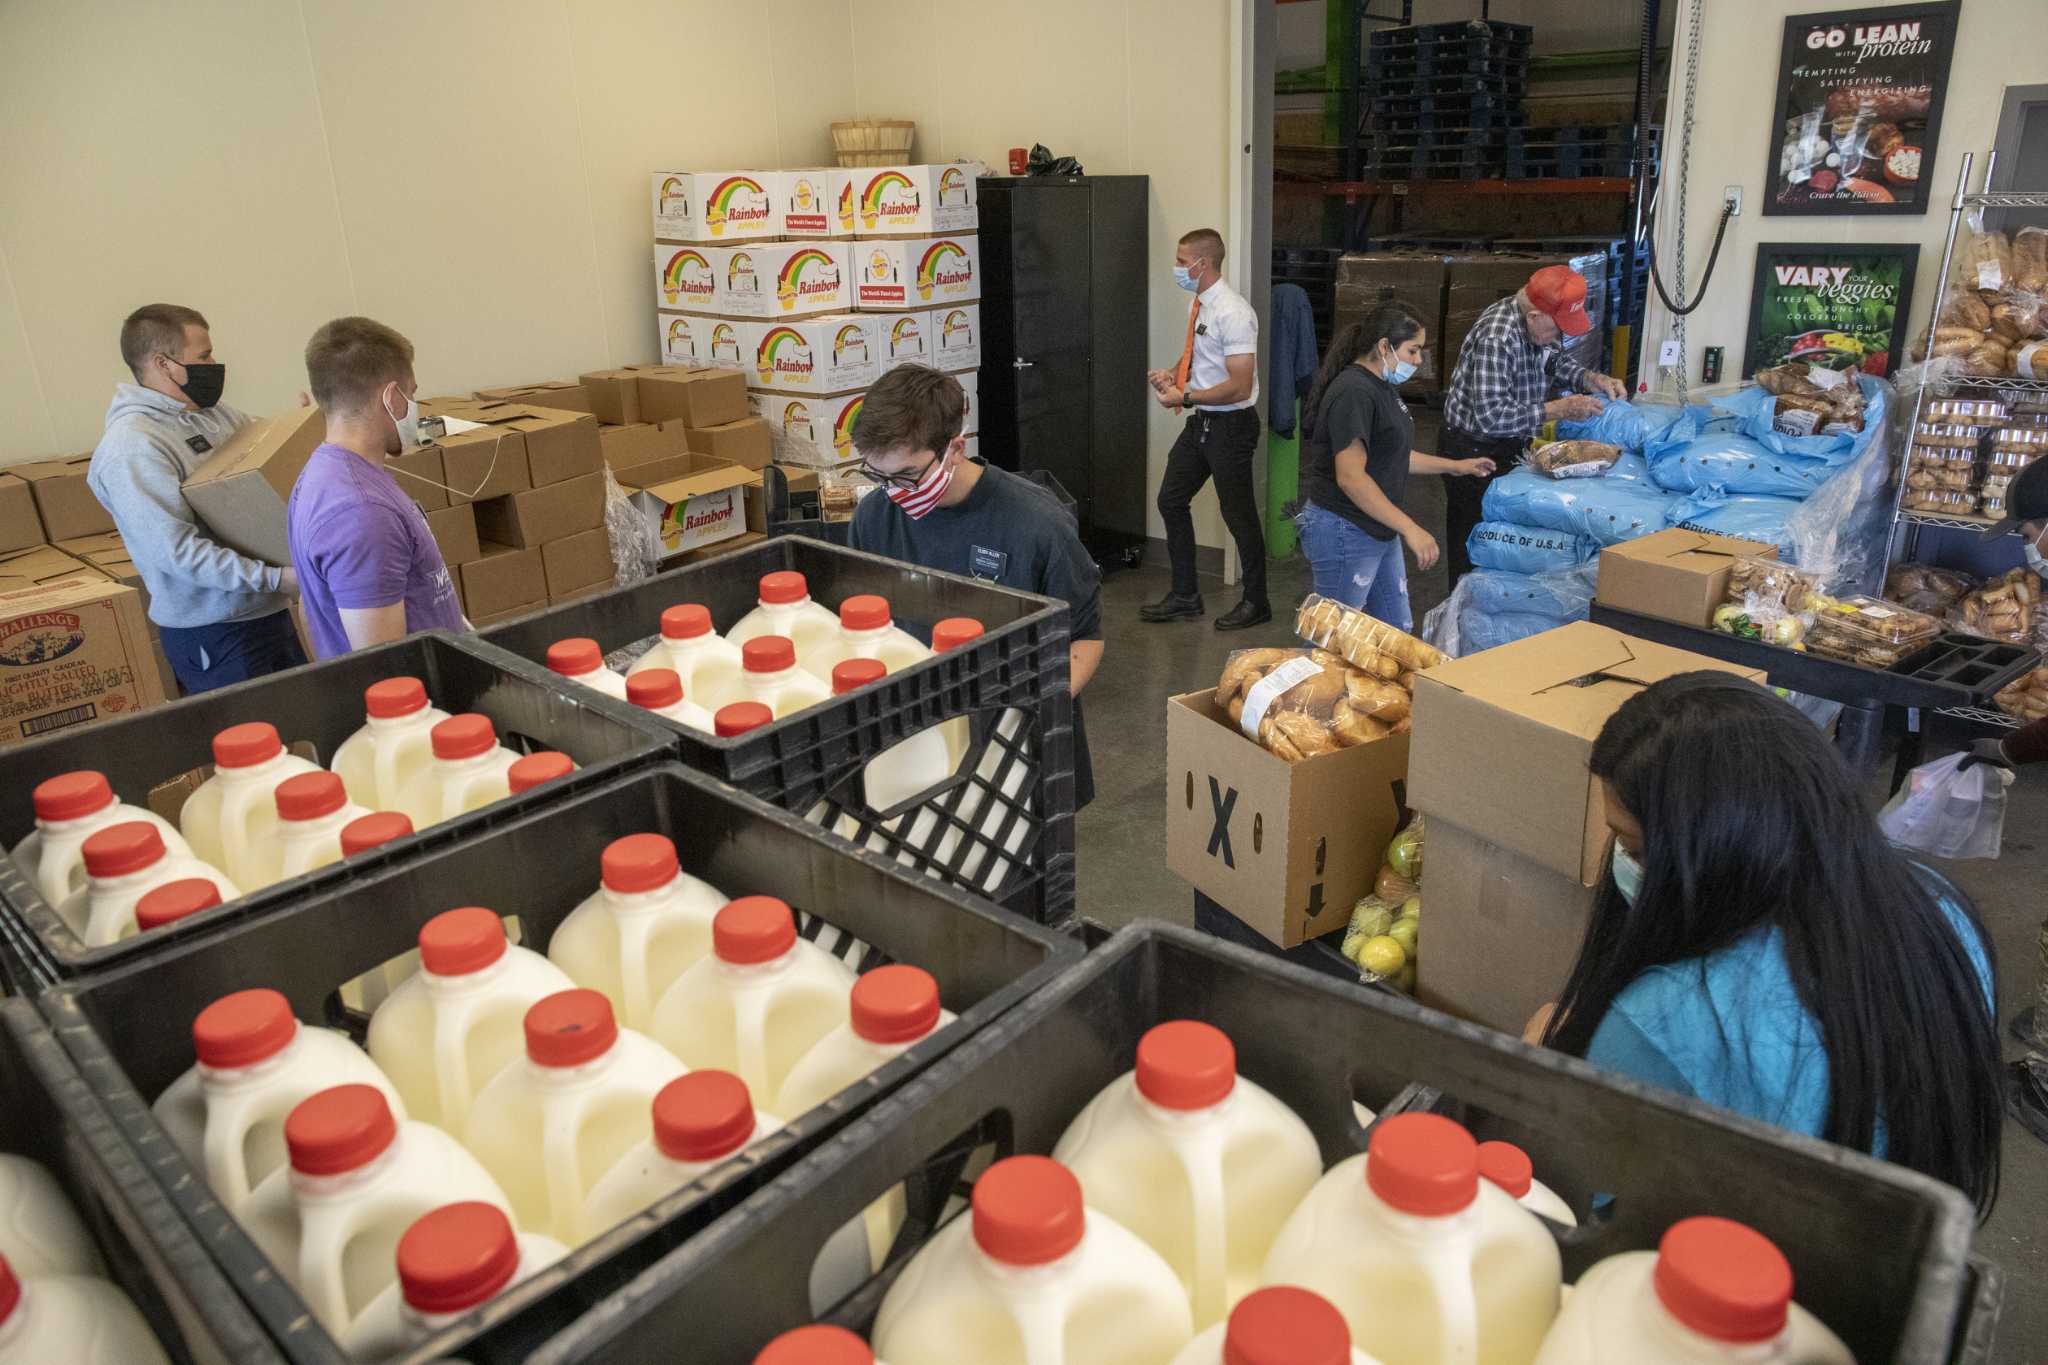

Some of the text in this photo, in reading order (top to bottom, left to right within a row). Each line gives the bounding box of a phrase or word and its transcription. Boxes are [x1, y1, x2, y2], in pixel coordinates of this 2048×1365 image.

[1806, 22, 1921, 49] GO LEAN
[1856, 39, 1932, 64] protein
[1798, 67, 1857, 77] TEMPTING
[1820, 75, 1893, 87] SATISFYING
[1849, 85, 1928, 97] ENERGIZING
[728, 207, 769, 221] Rainbow
[880, 202, 920, 215] Rainbow
[936, 270, 973, 286] Rainbow
[1775, 265, 1850, 286] VARY
[1817, 279, 1894, 304] veggies
[680, 279, 715, 294] Rainbow
[799, 279, 840, 295] Rainbow
[1786, 313, 1843, 322] COLORFUL
[1837, 323, 1878, 332] BRIGHT
[776, 357, 814, 373] Rainbow
[686, 508, 734, 530] Rainbow
[1476, 530, 1516, 544] ODUCE
[1518, 536, 1533, 546] OF
[0, 614, 77, 637] HALLENGE
